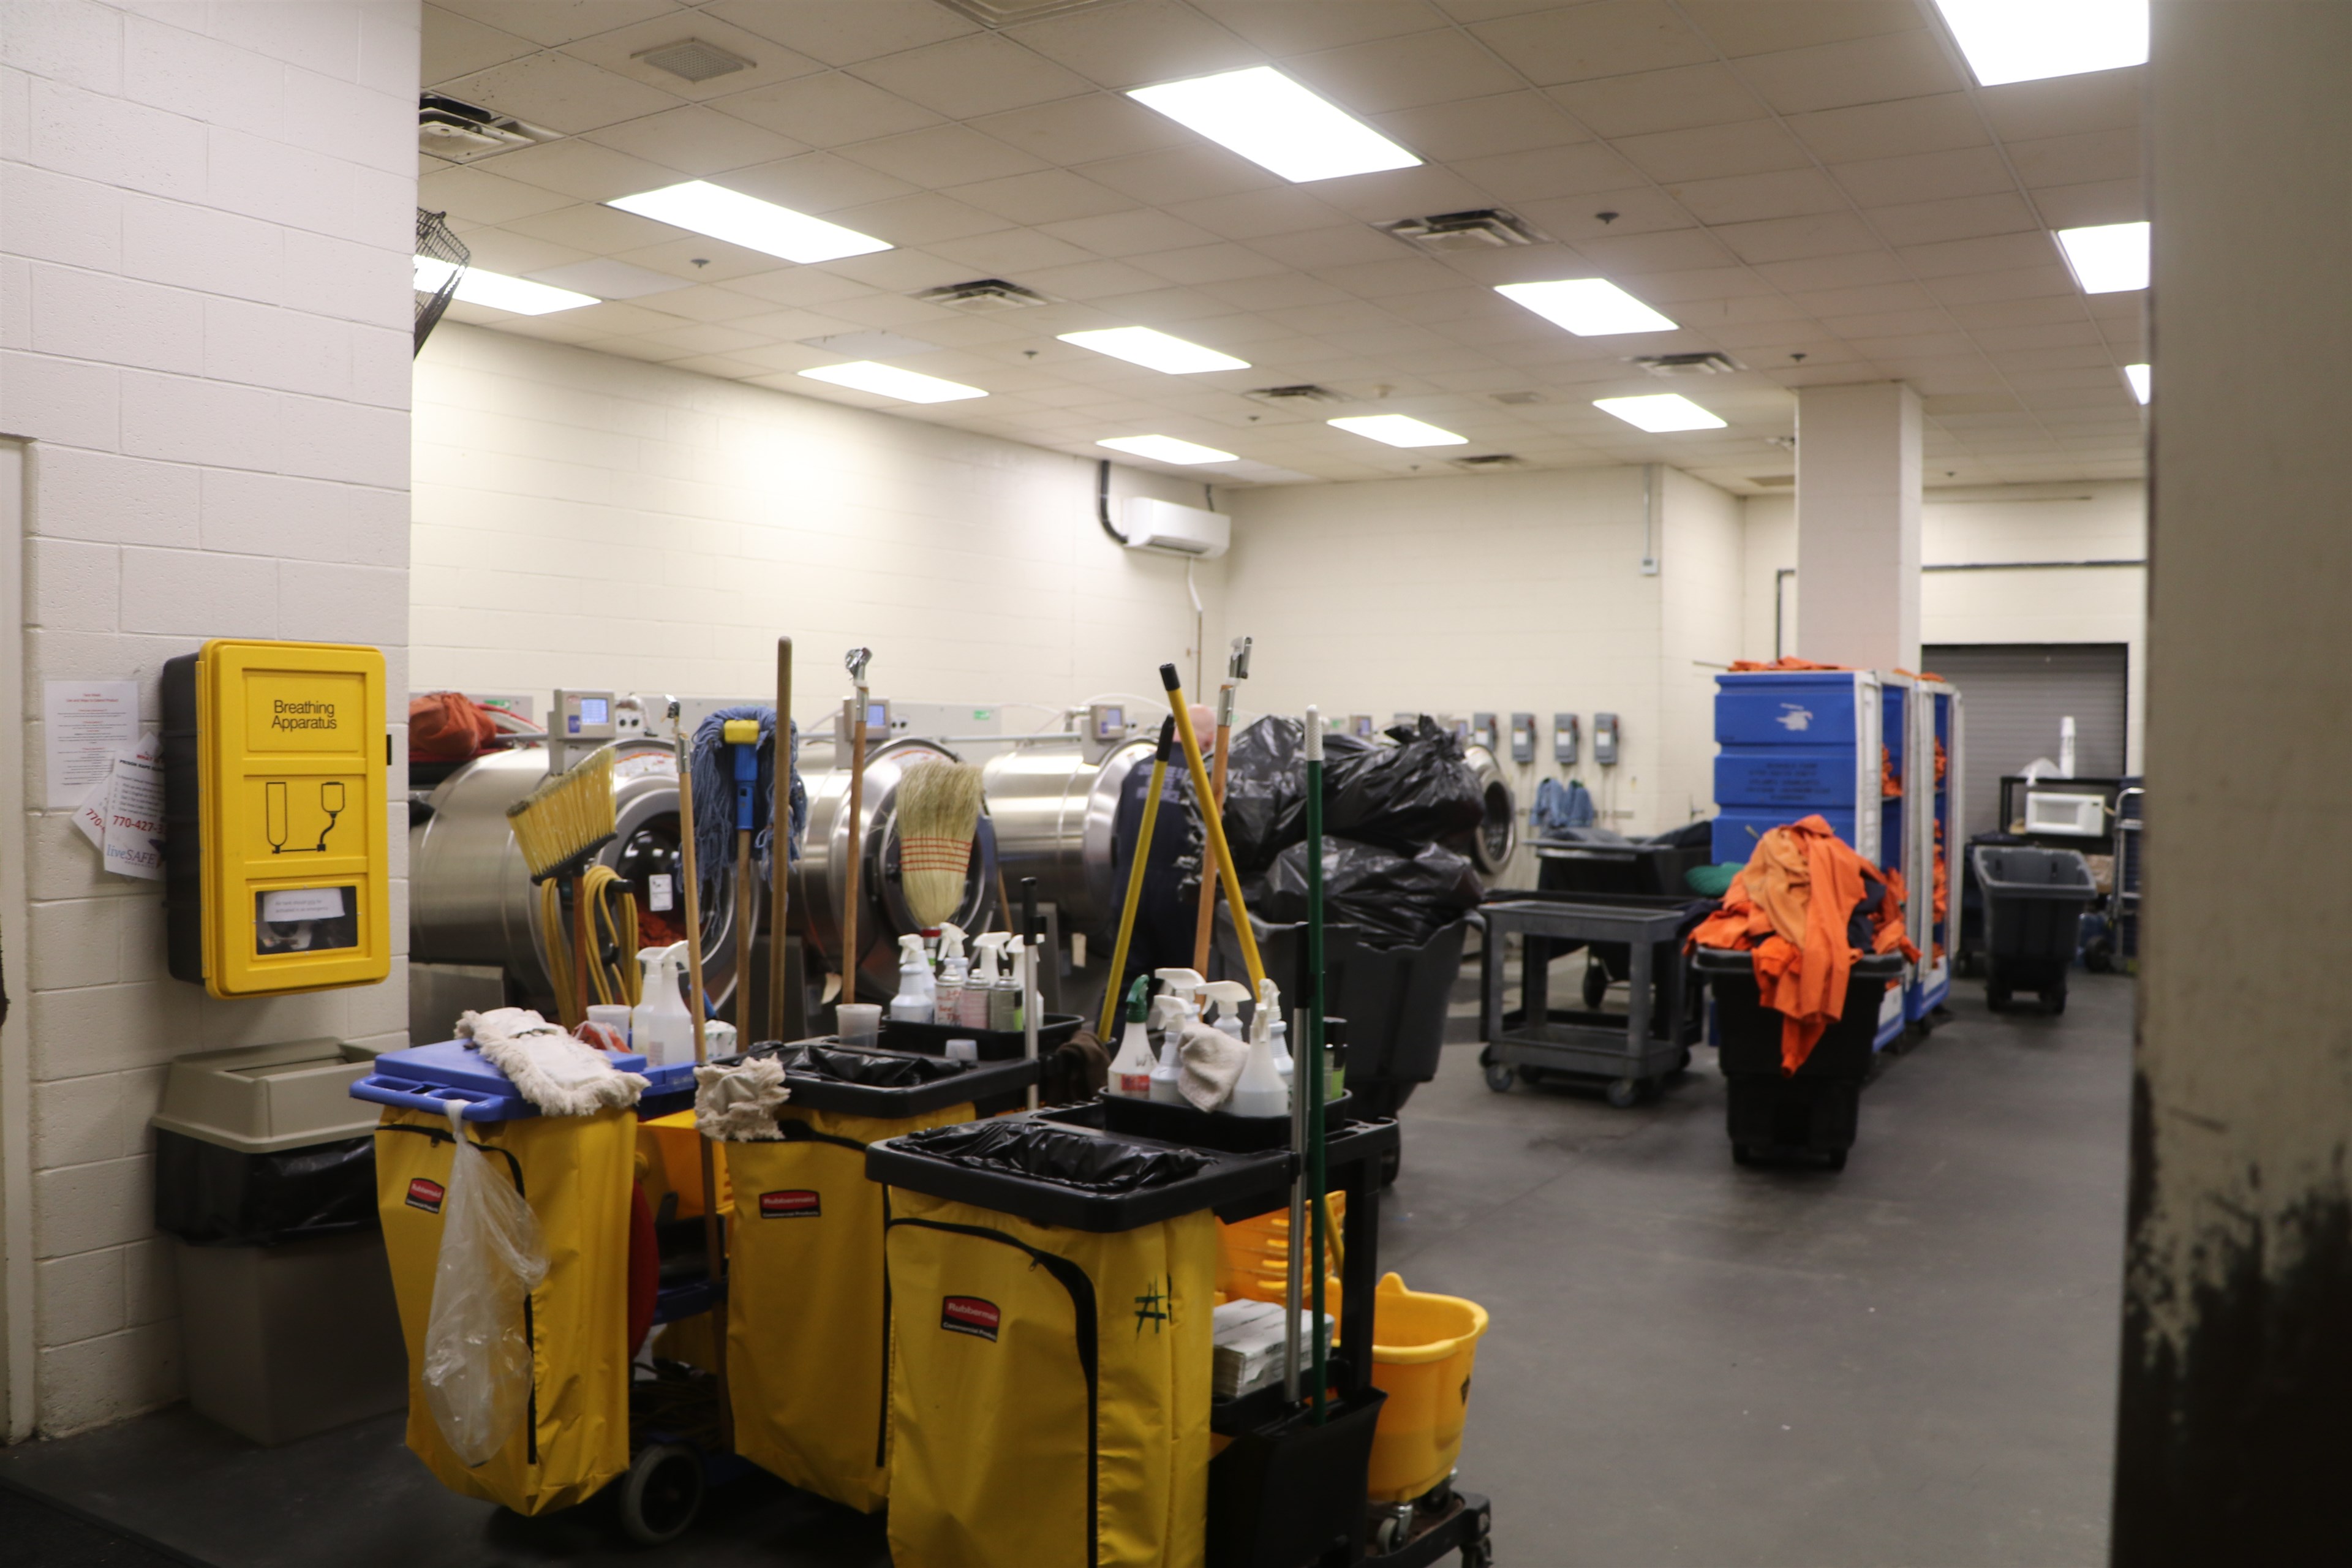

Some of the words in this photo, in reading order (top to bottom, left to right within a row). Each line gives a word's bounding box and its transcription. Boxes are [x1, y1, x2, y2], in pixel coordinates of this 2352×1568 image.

[274, 699, 334, 718] Breathing
[271, 715, 337, 732] Apparatus
[410, 1183, 442, 1198] Rubbermaid
[764, 1196, 816, 1205] Rubbermaid
